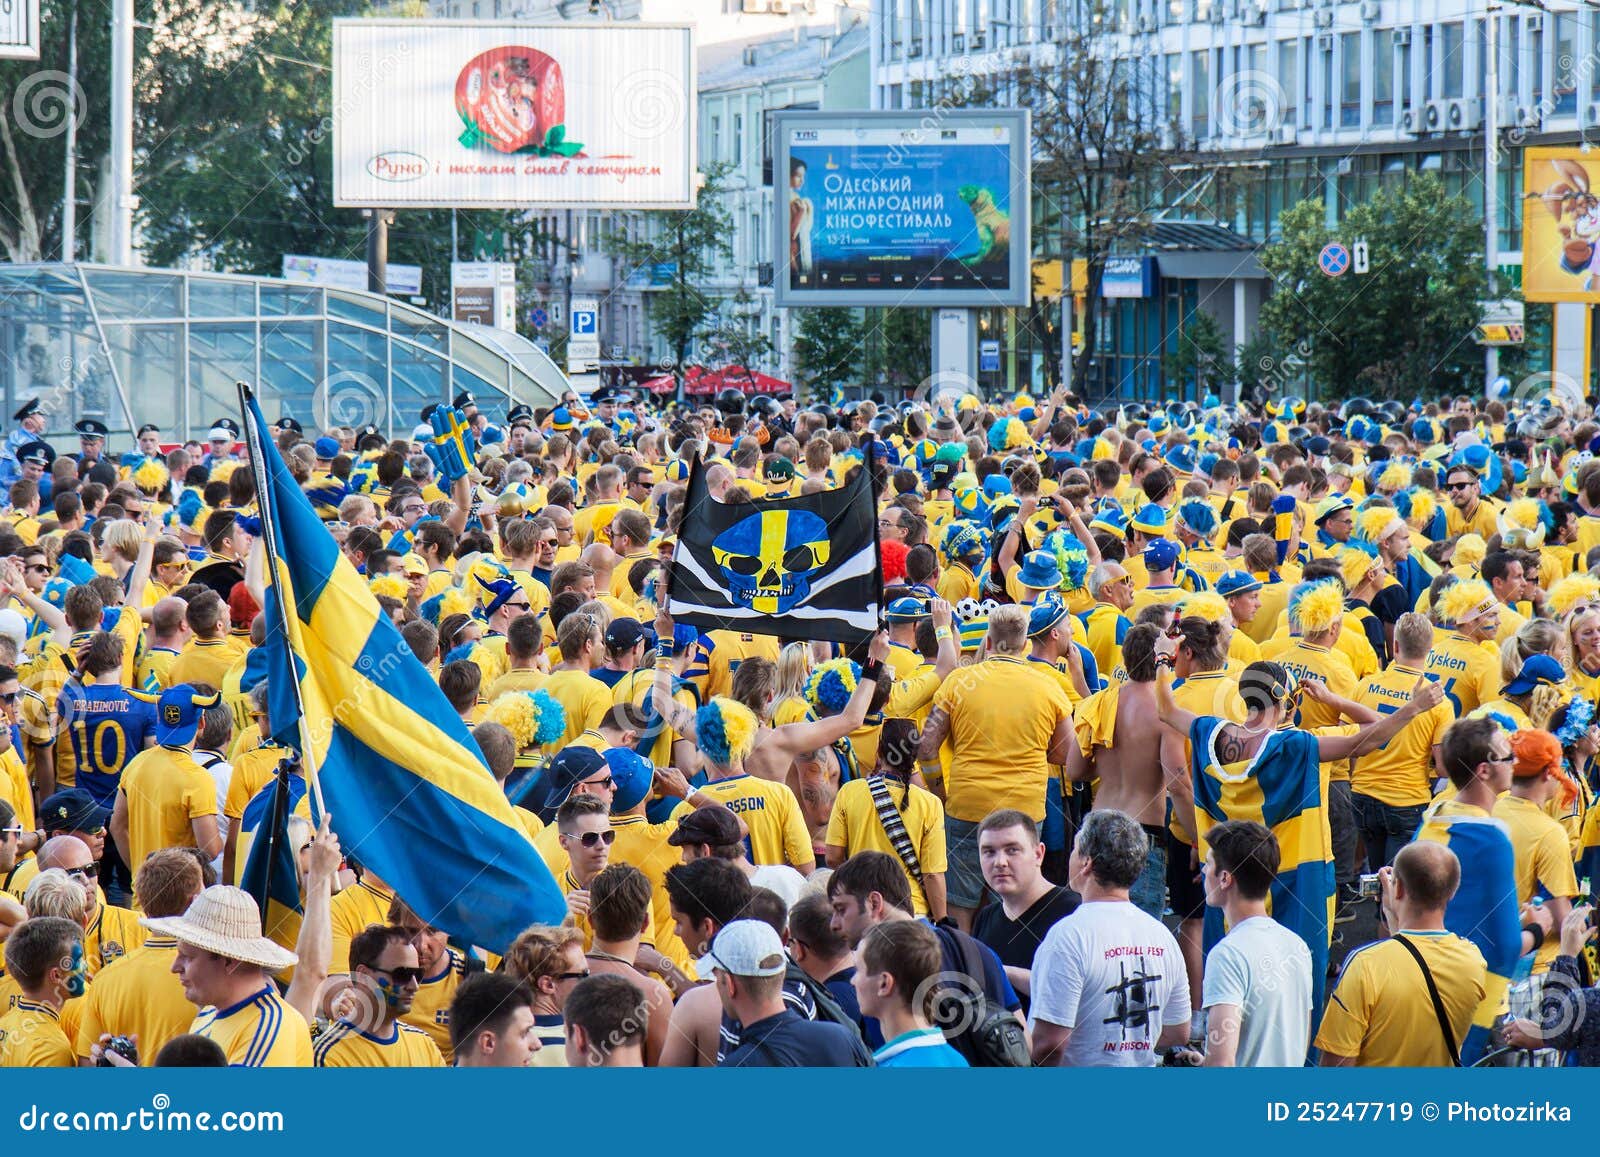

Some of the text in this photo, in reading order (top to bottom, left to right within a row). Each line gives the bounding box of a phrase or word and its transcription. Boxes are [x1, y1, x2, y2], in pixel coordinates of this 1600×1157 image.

[376, 156, 423, 179] Руна
[435, 160, 441, 174] і
[825, 193, 944, 211] МІЖНАРОДНИЙ
[825, 214, 952, 229] КІНОФЕСТИВАЛЬ
[577, 312, 592, 334] P
[1368, 684, 1412, 701] Macatt
[73, 720, 127, 775] 10
[1105, 946, 1164, 960] FOOTBALL FEST
[1104, 1042, 1151, 1052] IN PRISON
